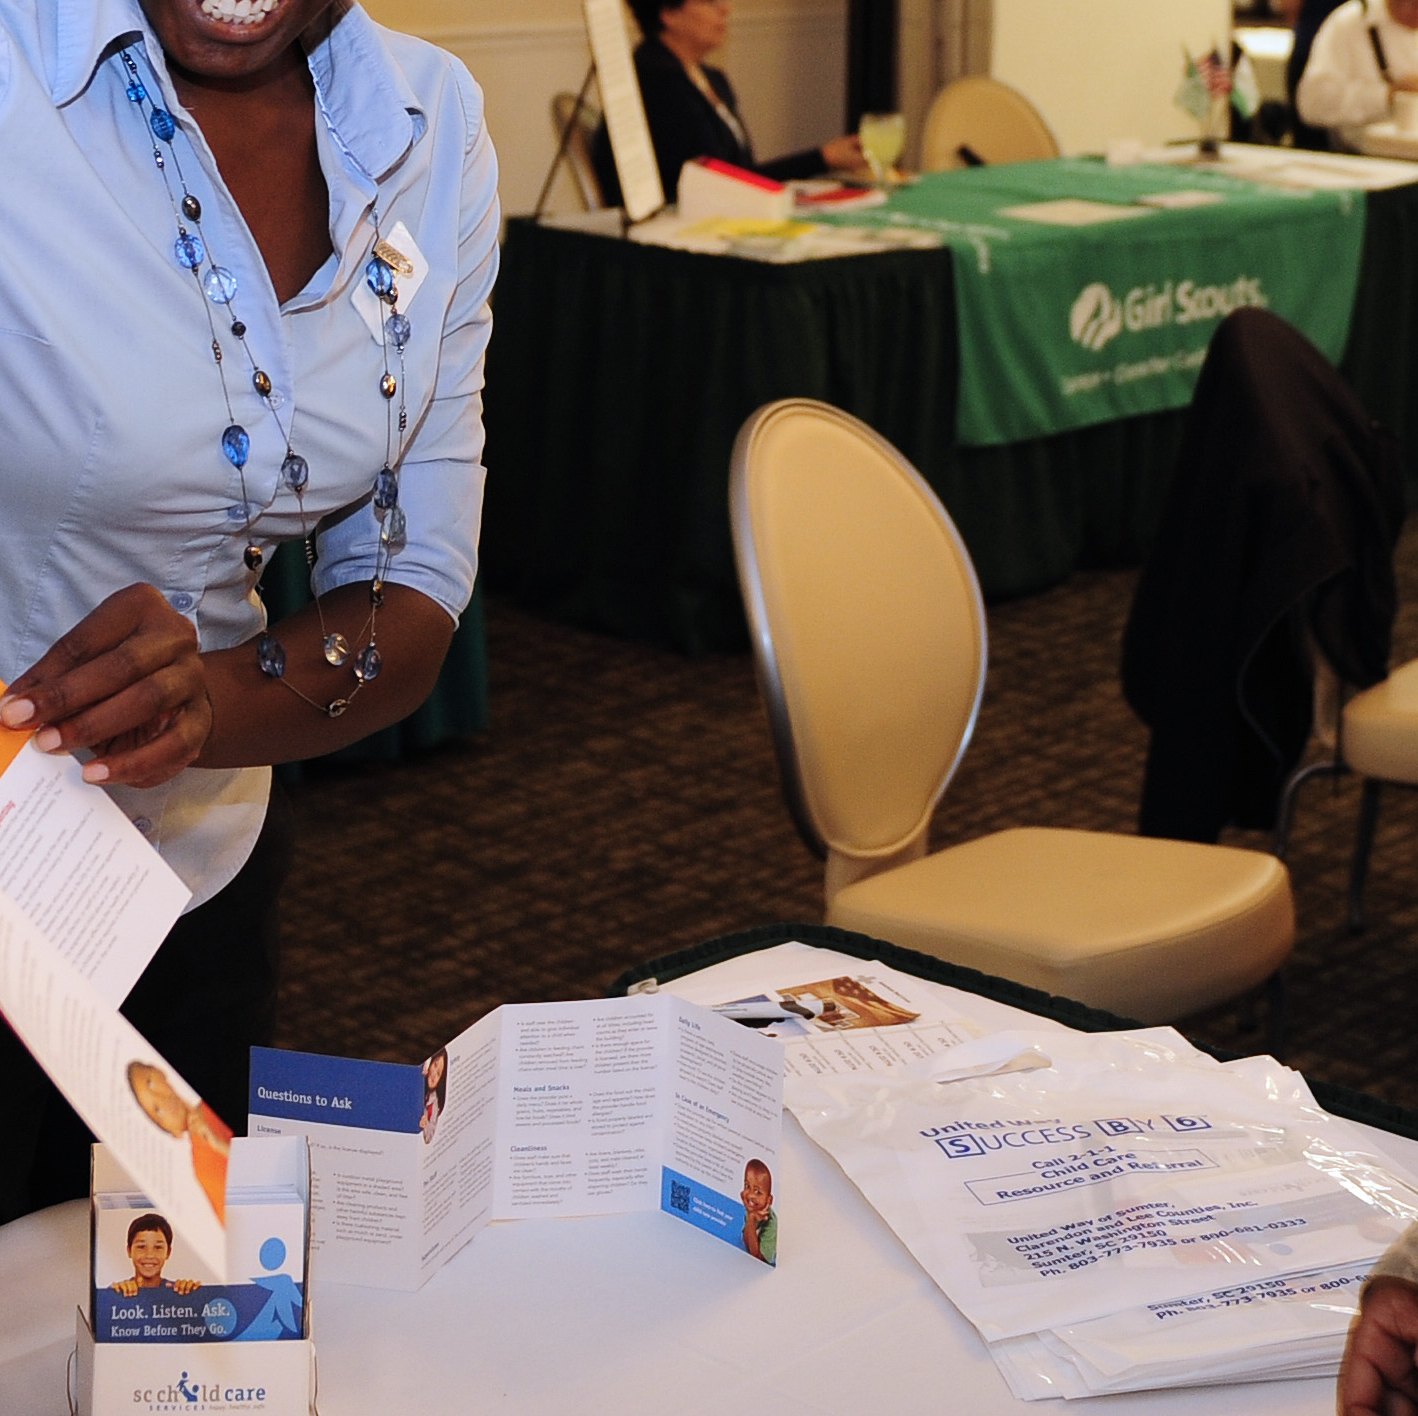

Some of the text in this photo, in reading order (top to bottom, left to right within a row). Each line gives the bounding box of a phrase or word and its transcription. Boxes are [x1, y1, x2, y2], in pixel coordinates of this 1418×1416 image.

[257, 1086, 353, 1110] Questions to Ask
[548, 1084, 570, 1093] Snacks
[919, 1119, 1005, 1138] United
[943, 1125, 1093, 1156] SUCCESS
[1107, 1118, 1156, 1134] BY
[510, 1145, 548, 1153] Cleanliness
[1031, 1144, 1117, 1170] Call 2-1-1
[1040, 1150, 1138, 1180] Child Care
[996, 1175, 1086, 1200] Resource
[1089, 1164, 1124, 1180] and
[1007, 1226, 1063, 1245] United
[1064, 1218, 1095, 1234] Way
[1097, 1214, 1112, 1224] of
[1014, 1200, 1258, 1253] Clarendon and Lee Counties, Inc.
[1024, 1214, 1217, 1262] 215 N. Washington Street
[1031, 1229, 1167, 1270] Sumter, SC 29150
[1039, 1265, 1067, 1278] Ph.
[1068, 1237, 1177, 1271] 803-773-7935
[1181, 1235, 1197, 1245] or
[111, 1303, 231, 1320] Look. Listen. Ask.
[1156, 1308, 1183, 1320] Ph.
[1301, 1286, 1316, 1294] or
[111, 1323, 227, 1338] Know Before They Go.
[133, 1388, 153, 1403] sc
[225, 1387, 266, 1402] care
[149, 1404, 205, 1412] SERVICES
